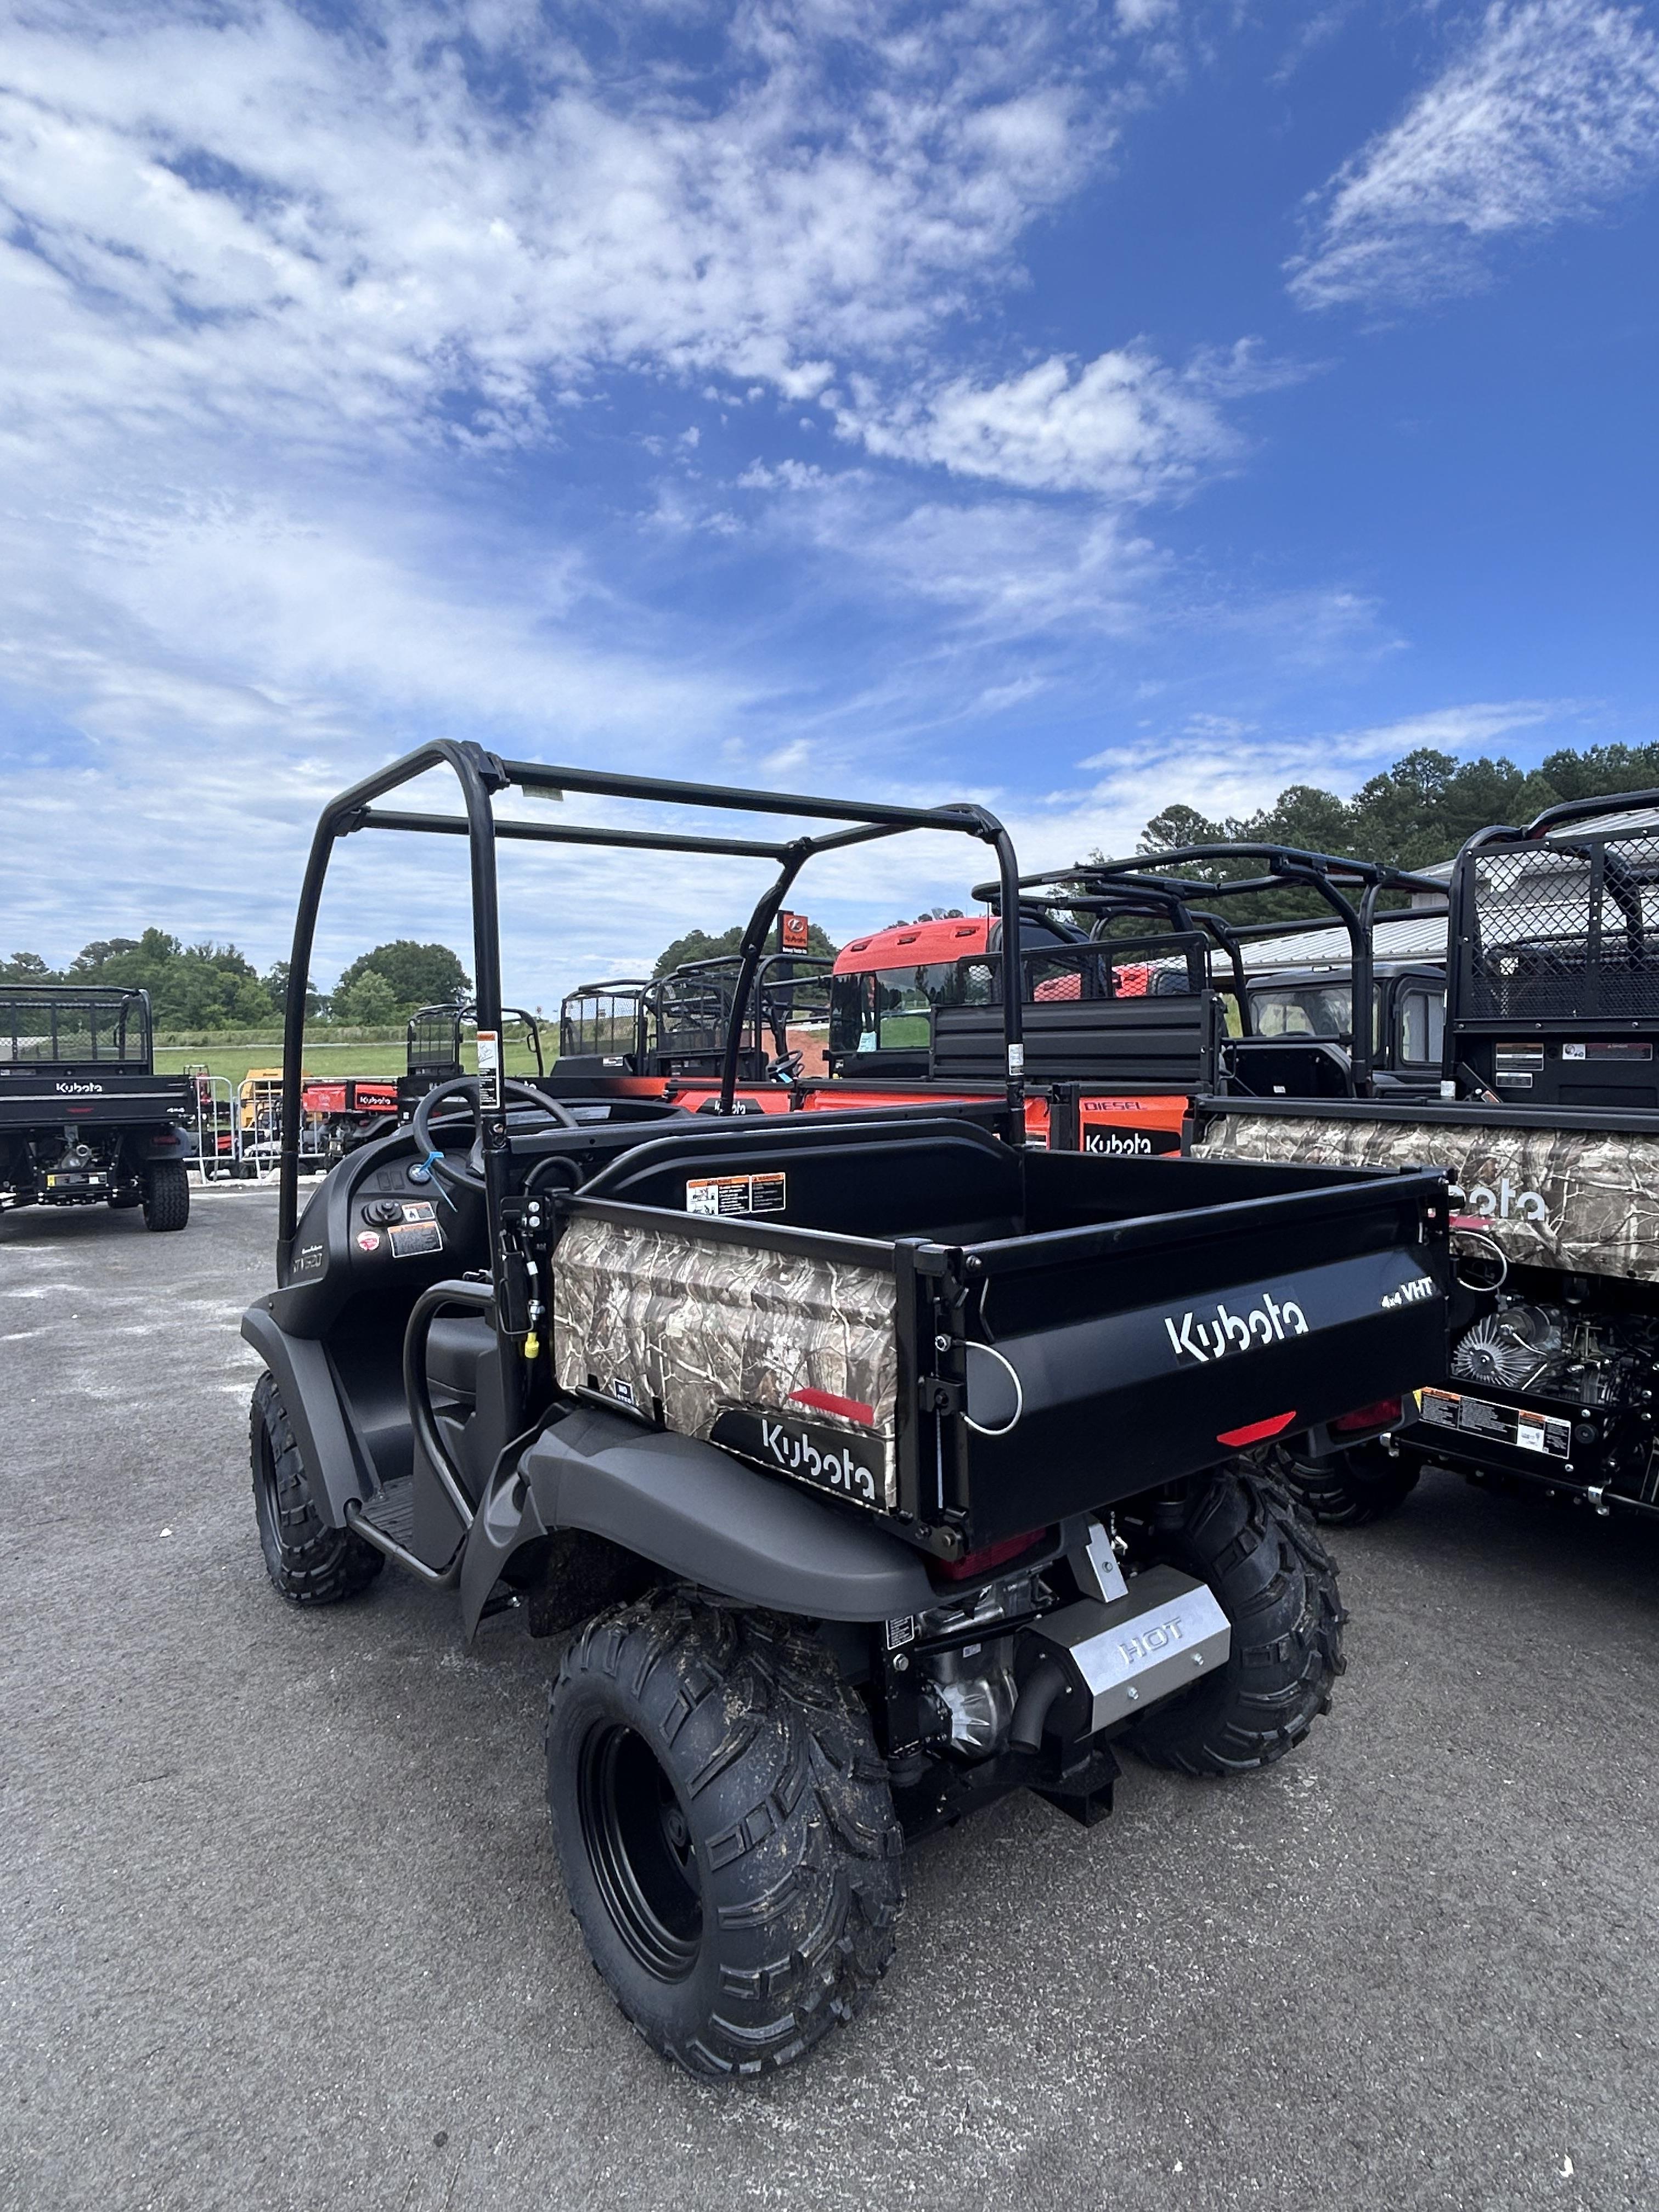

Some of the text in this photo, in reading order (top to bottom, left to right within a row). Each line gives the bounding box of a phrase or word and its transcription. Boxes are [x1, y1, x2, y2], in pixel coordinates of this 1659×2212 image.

[56, 1082, 103, 1093] Kubota
[360, 1096, 391, 1105] Kubota
[714, 1099, 746, 1115] Kota
[1084, 1102, 1148, 1111] DIESEL
[1086, 1132, 1151, 1155] Kubota
[1381, 1276, 1432, 1308] 4x4 VHT
[1164, 1293, 1309, 1362] Kubota
[761, 1418, 876, 1500] Kubota
[1118, 1615, 1183, 1666] HOT
